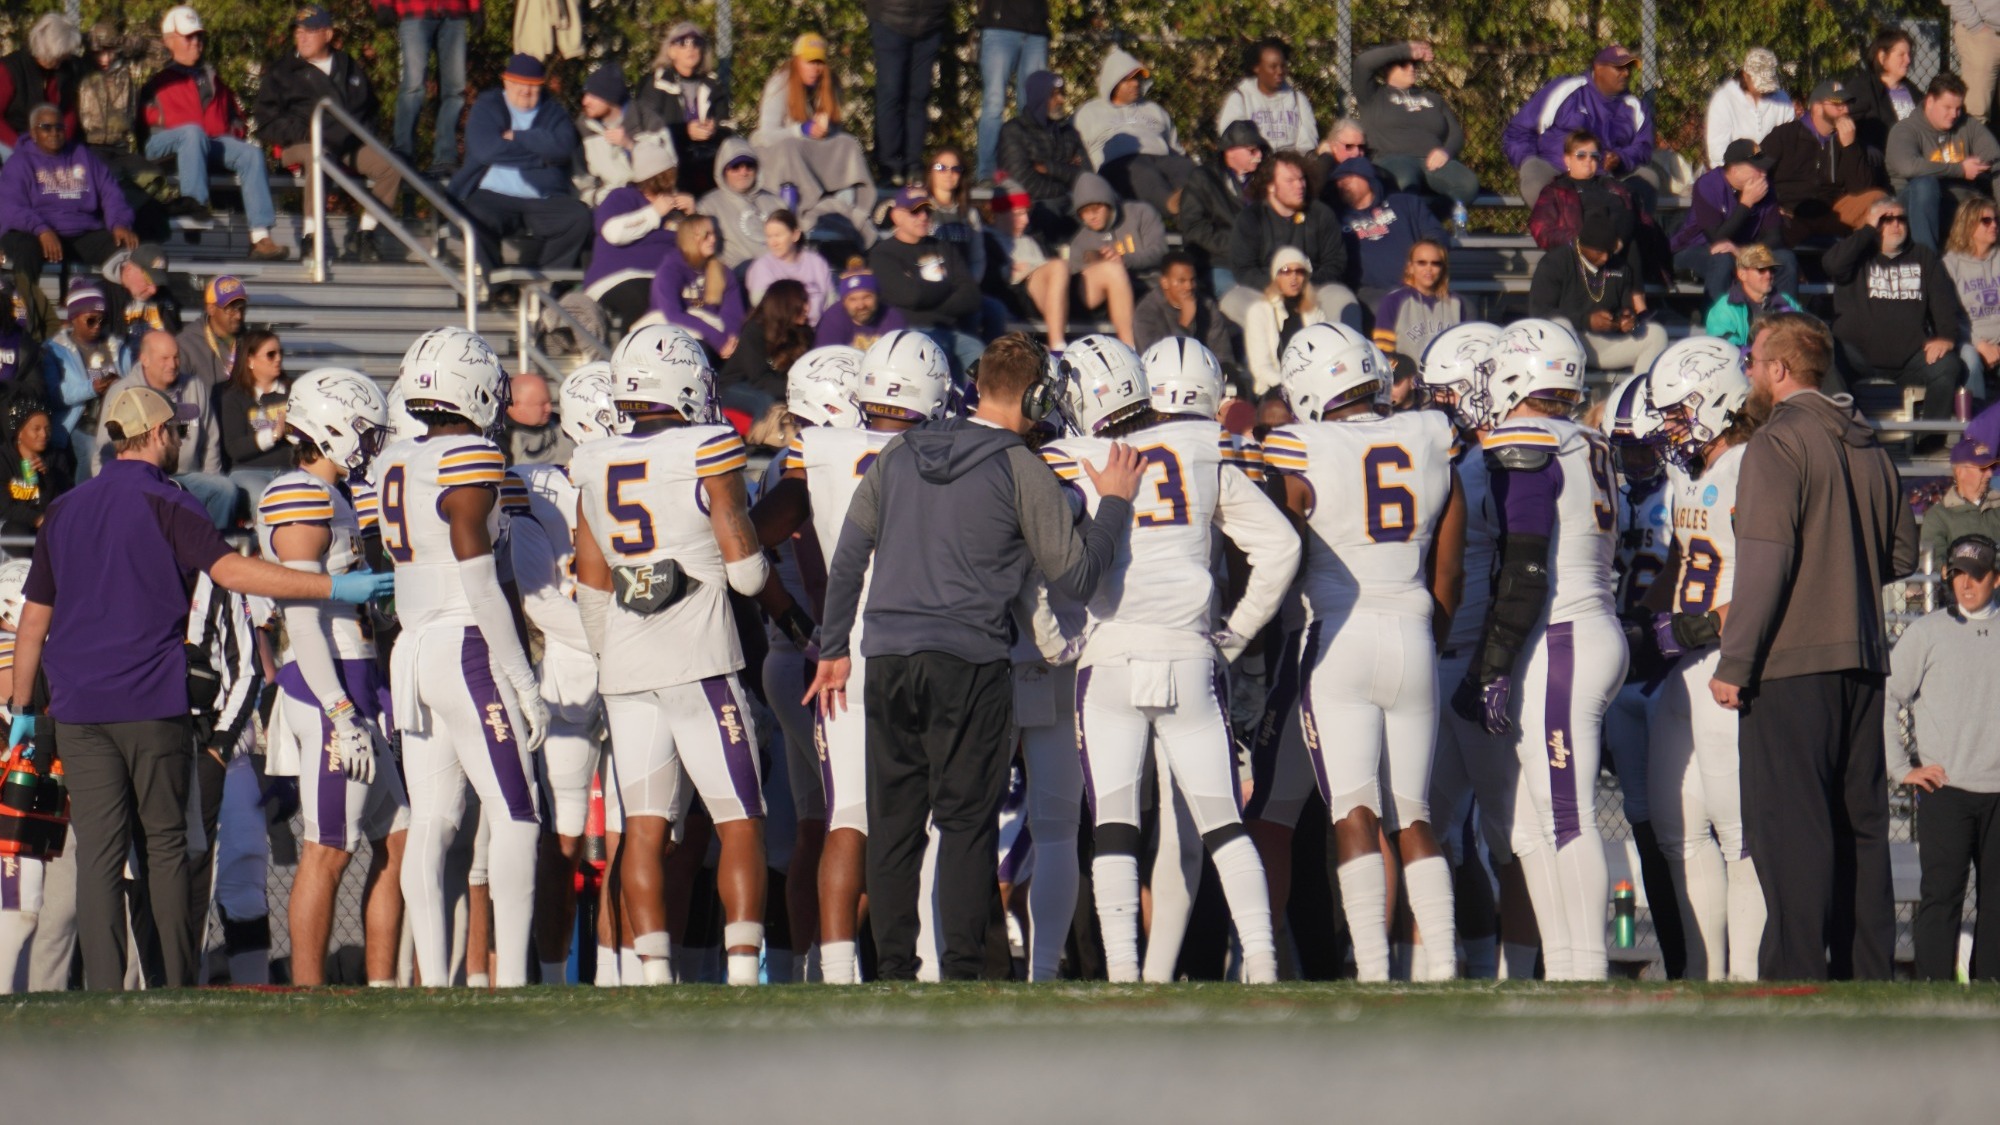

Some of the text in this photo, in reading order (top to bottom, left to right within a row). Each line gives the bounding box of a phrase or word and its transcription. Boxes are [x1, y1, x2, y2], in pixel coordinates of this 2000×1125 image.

[1361, 358, 1371, 374] 6
[1564, 362, 1577, 377] 9
[419, 374, 431, 389] 9
[627, 377, 639, 392] 5
[886, 382, 901, 397] 2
[1121, 379, 1133, 398] 3
[619, 402, 649, 411] AGLES
[864, 403, 906, 417] EAGLES
[1362, 443, 1418, 544] 6
[382, 464, 413, 563] 9
[606, 460, 658, 557] 5
[1674, 508, 1708, 531] AGLES
[485, 703, 509, 743] Eagles
[720, 705, 742, 744] Eagles
[1548, 728, 1571, 769] Eagles
